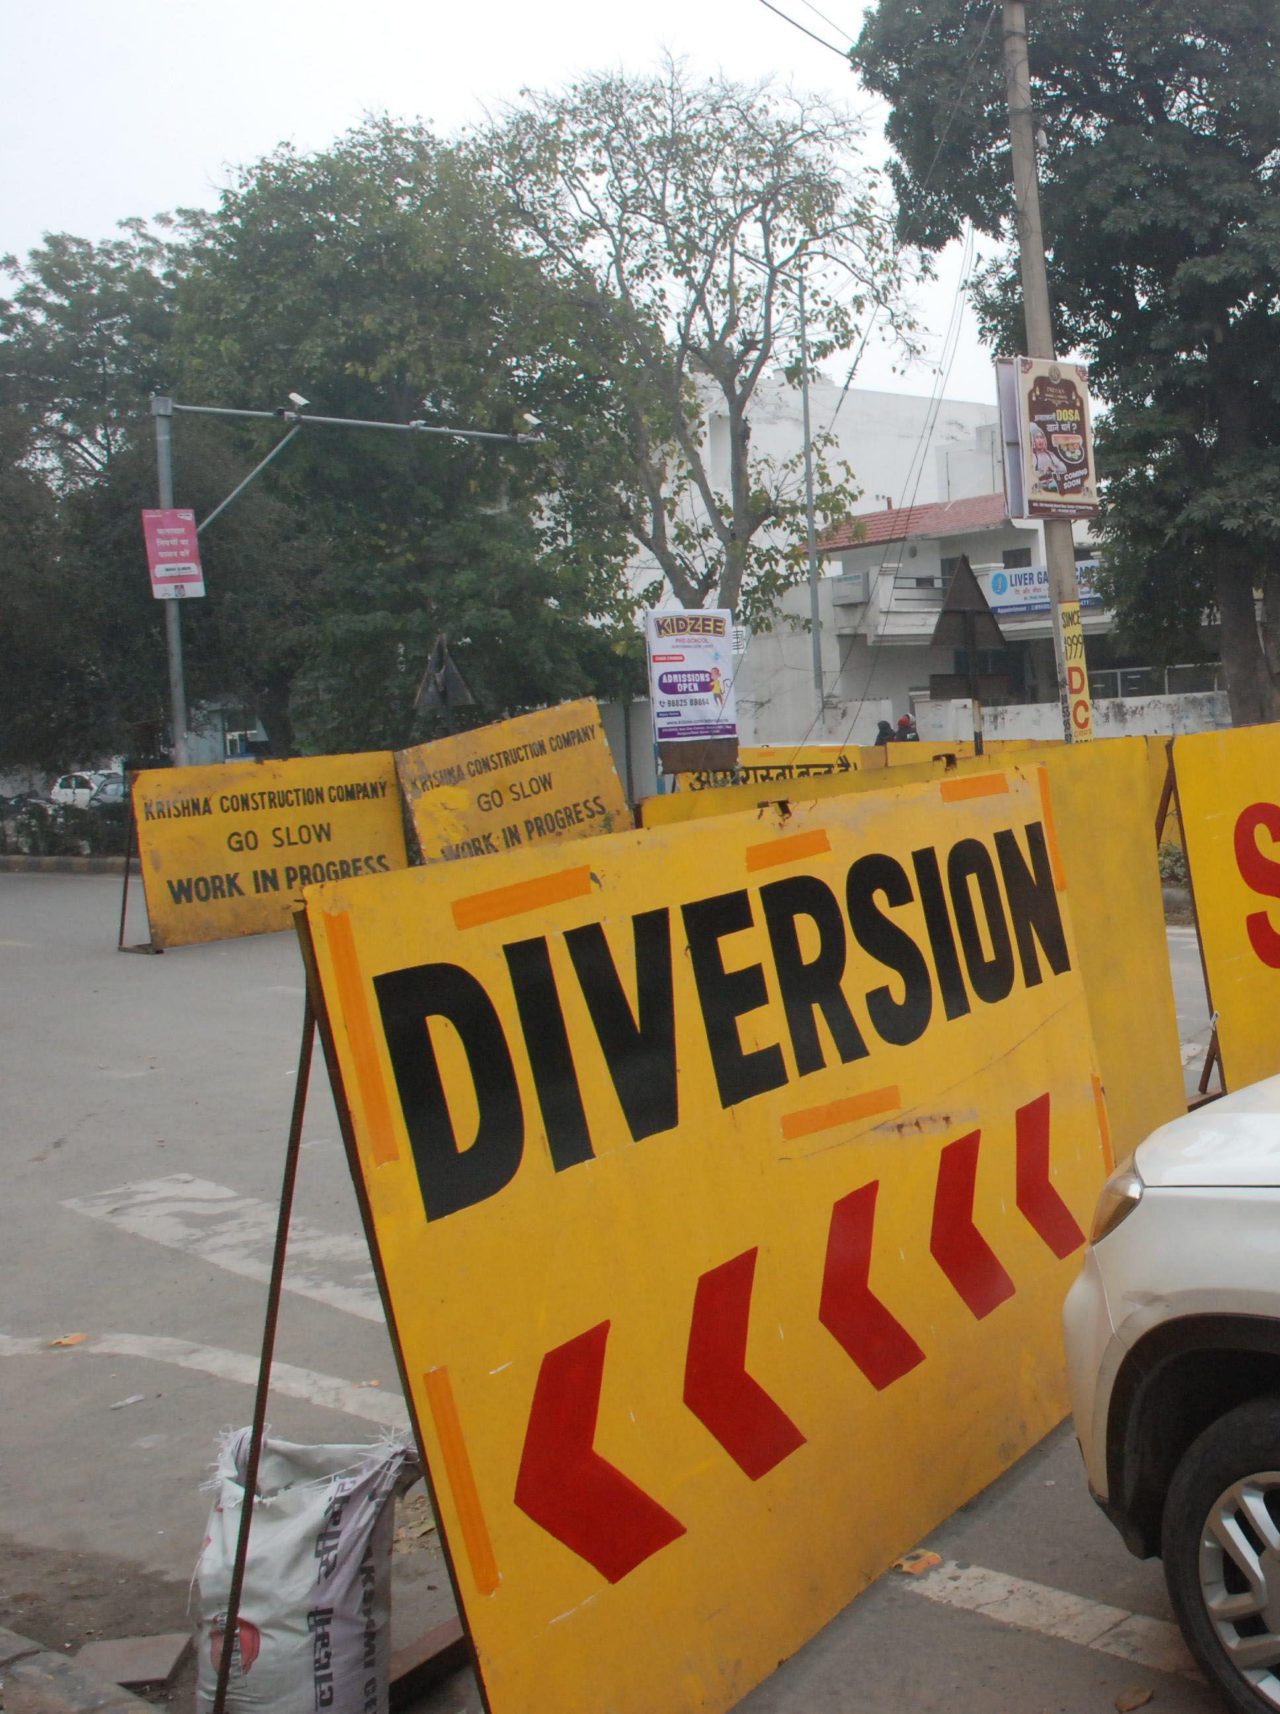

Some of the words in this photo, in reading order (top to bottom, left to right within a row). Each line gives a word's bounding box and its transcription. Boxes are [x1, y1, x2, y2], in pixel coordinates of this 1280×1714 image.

[1056, 409, 1080, 422] DOSA
[1063, 479, 1081, 490] SOON
[1064, 468, 1088, 480] COMING
[1009, 572, 1034, 587] LIVER
[655, 615, 726, 638] KIDZEE
[1061, 609, 1081, 630] SINCE
[662, 673, 710, 684] ADMISSIONS
[677, 683, 699, 692] OPEN
[410, 764, 465, 793] KRISHNA
[467, 739, 547, 778] CONSTRUCTION
[549, 724, 596, 751] COMPANY
[144, 797, 212, 821] KRISHNA
[220, 787, 325, 814] CONSTRUCTION
[328, 780, 387, 803] COMPANY
[476, 789, 504, 812] GO
[508, 772, 553, 802] SLOW
[227, 830, 258, 852] GO
[272, 822, 332, 848] SLOW
[440, 832, 499, 860] WORK
[501, 823, 523, 849] IN
[524, 796, 607, 841] PROGRESS
[167, 872, 246, 905] WORK
[253, 867, 280, 894] IN
[285, 854, 391, 890] PROGRESS
[373, 822, 1071, 1222] DIVERSION
